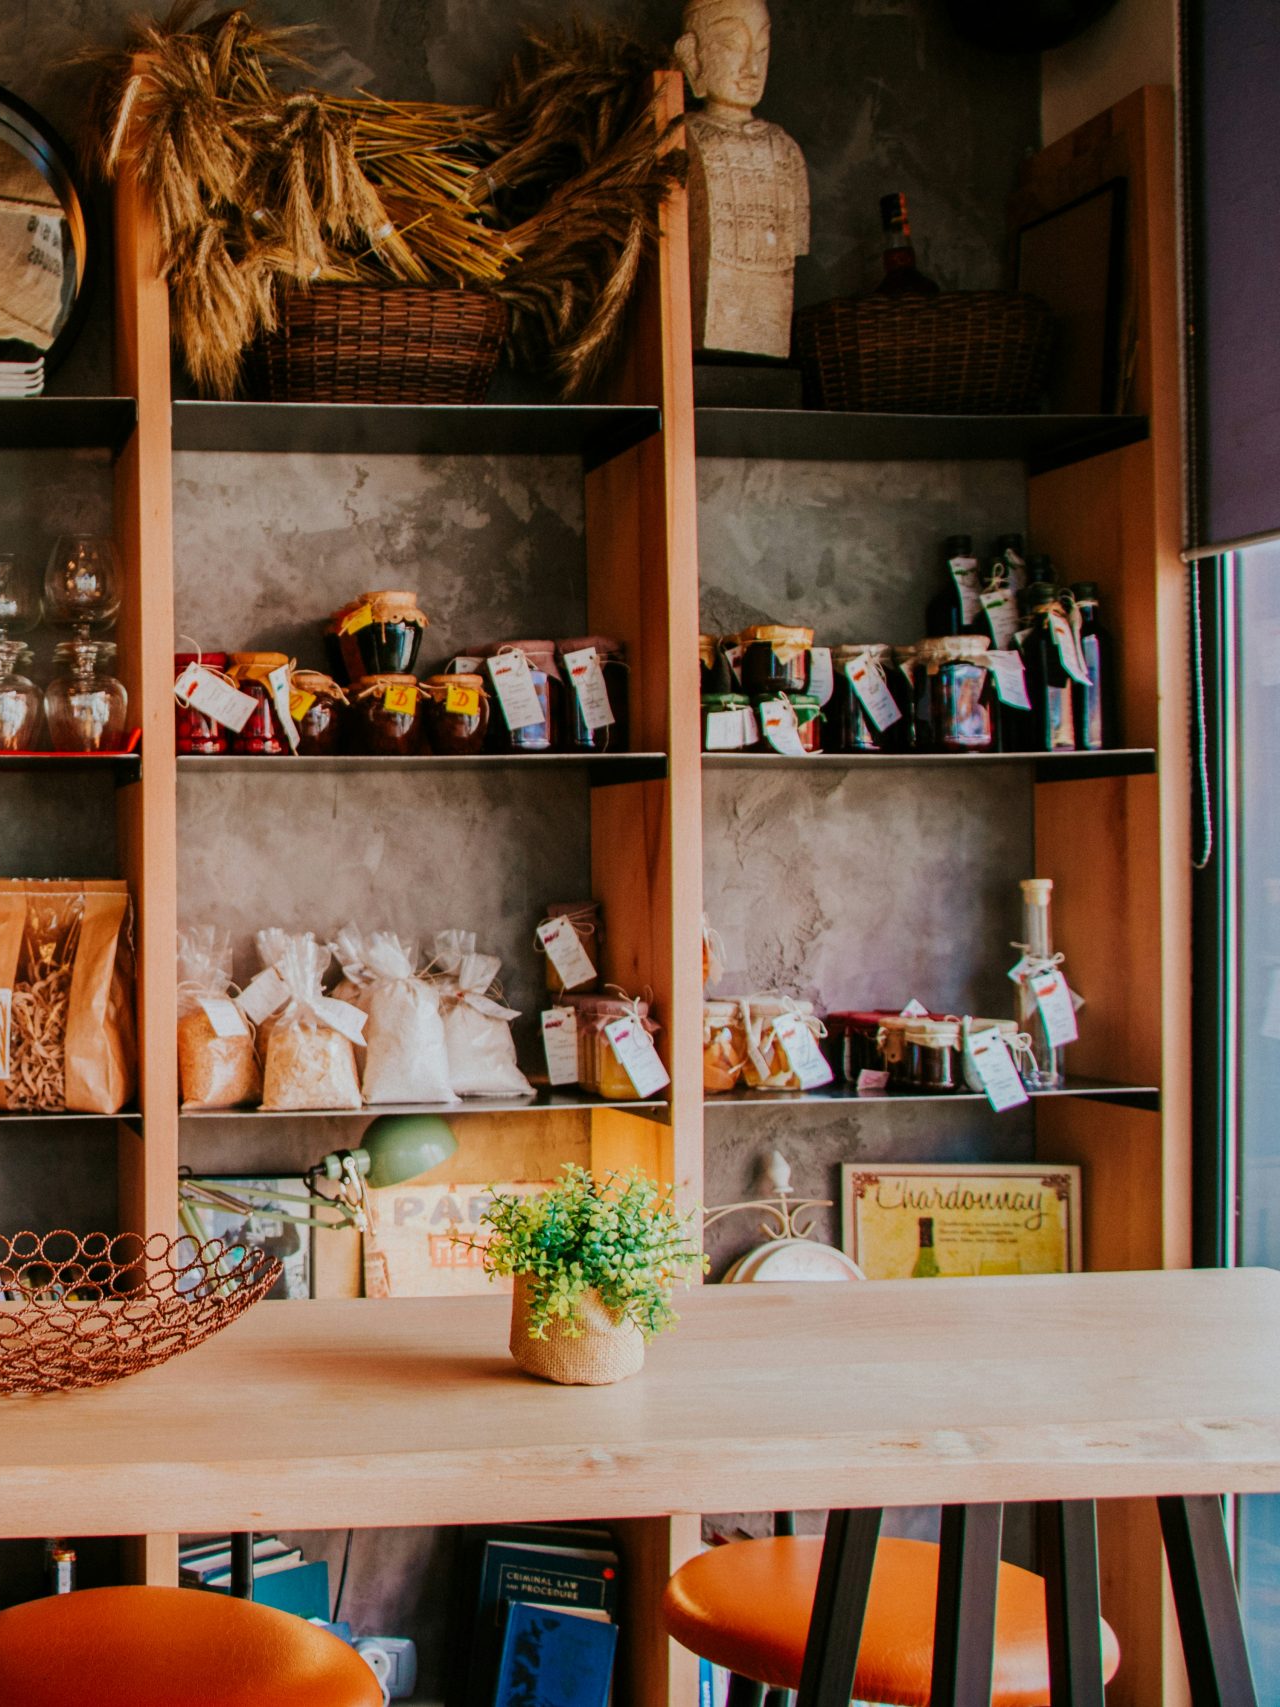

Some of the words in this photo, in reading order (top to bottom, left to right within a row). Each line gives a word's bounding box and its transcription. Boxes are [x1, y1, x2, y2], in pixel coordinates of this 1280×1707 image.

[876, 1180, 1049, 1230] Chardonnay
[506, 1572, 552, 1586] CRIMINAL
[557, 1580, 578, 1589] LAW
[521, 1586, 578, 1600] PROCEDURE
